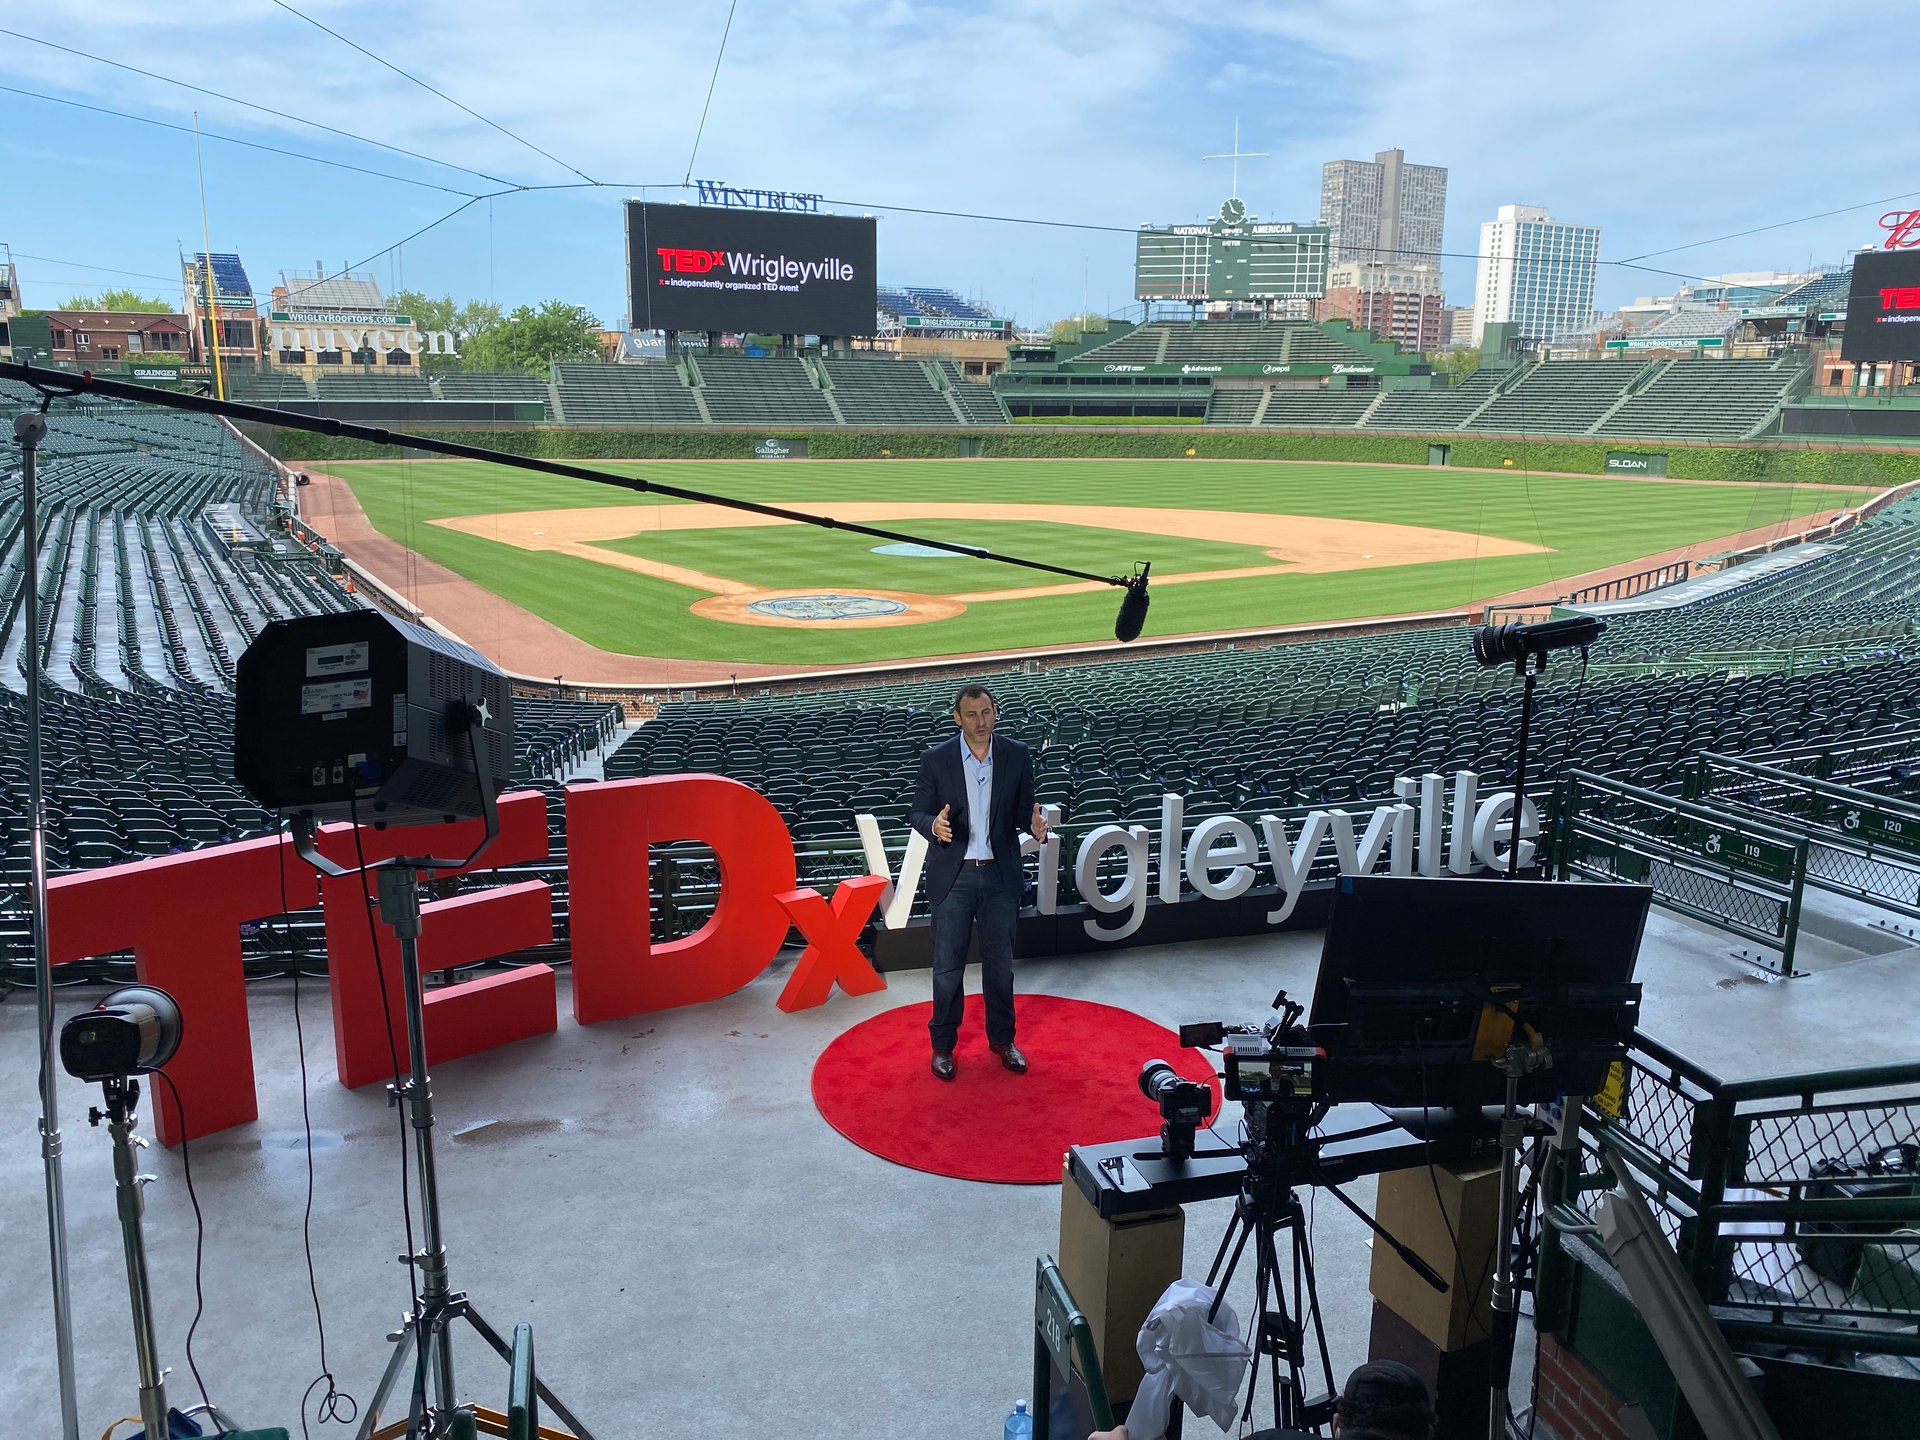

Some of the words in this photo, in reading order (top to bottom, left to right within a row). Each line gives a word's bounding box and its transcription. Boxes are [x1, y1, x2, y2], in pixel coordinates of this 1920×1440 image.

[695, 180, 823, 212] WINTRUST
[1173, 227, 1212, 235] NATIONAL
[1252, 225, 1292, 233] AMERICAN
[670, 278, 724, 290] independently
[725, 281, 761, 290] organized
[762, 283, 778, 291] TED
[779, 284, 799, 292] event
[288, 313, 397, 324] WRIGLEYROOFTOPS.COM
[920, 318, 991, 328] WRIGLEYROOFTOPS.COM
[1888, 315, 1920, 323] indepen
[271, 327, 458, 355] nuveen
[1628, 339, 1699, 347] WRIGLEYROOFTOPS.COM
[134, 369, 177, 377] GRAINGER
[1271, 365, 1290, 373] pepsi
[1332, 364, 1374, 374] Budweiser
[755, 447, 789, 455] Gallagher
[1609, 459, 1647, 468] SLOAN
[1884, 819, 1902, 833] 120
[855, 770, 1543, 941] Wigleyville
[1744, 844, 1760, 858] 119
